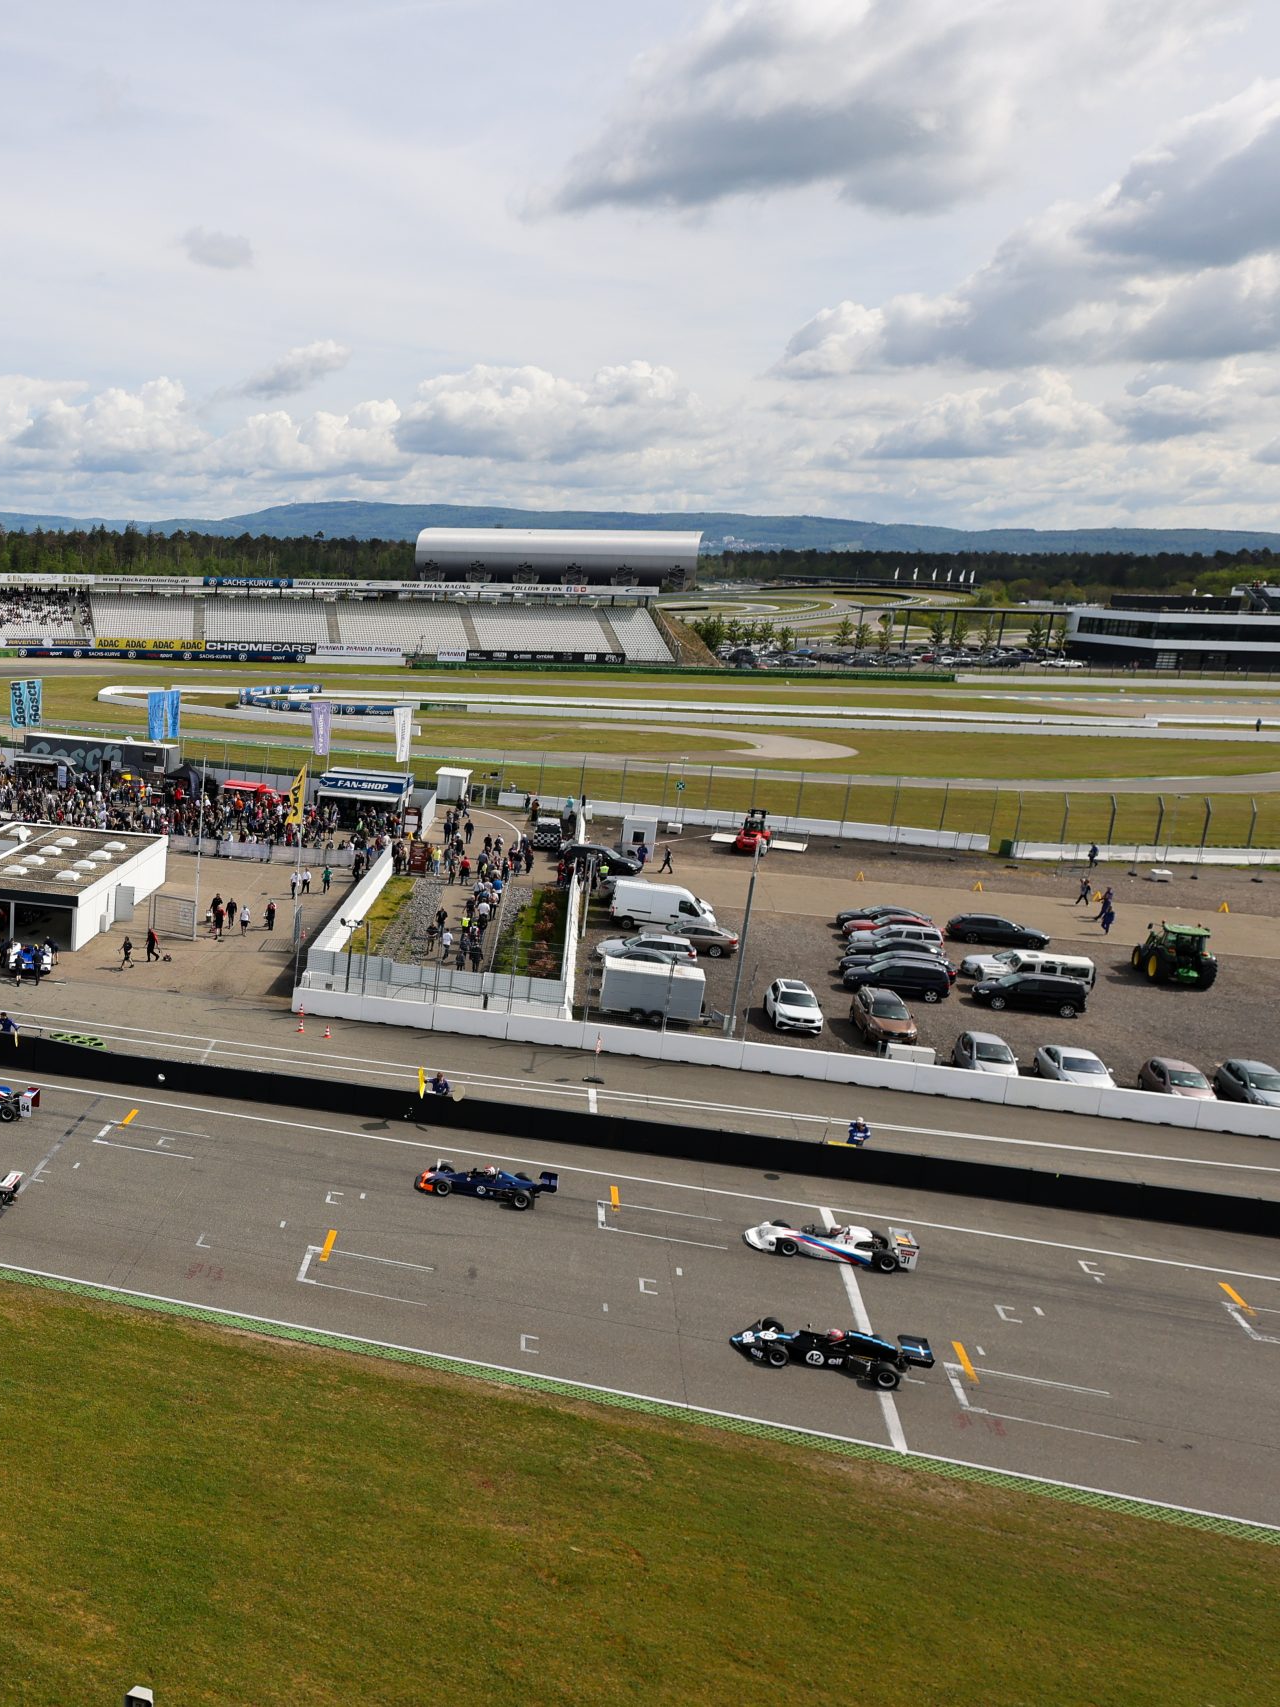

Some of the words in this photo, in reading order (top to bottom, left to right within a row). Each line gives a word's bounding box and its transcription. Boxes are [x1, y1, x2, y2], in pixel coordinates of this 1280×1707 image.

[222, 578, 274, 587] SACHS-KURVE
[98, 639, 119, 648] ADAC
[125, 640, 146, 649] ADAC
[152, 641, 174, 649] ADAC
[181, 641, 203, 650] ADAC
[337, 779, 389, 791] FAN-SHOP
[900, 1255, 910, 1264] 31
[750, 1347, 764, 1359] elf
[808, 1352, 821, 1362] 42
[827, 1357, 843, 1365] elf
